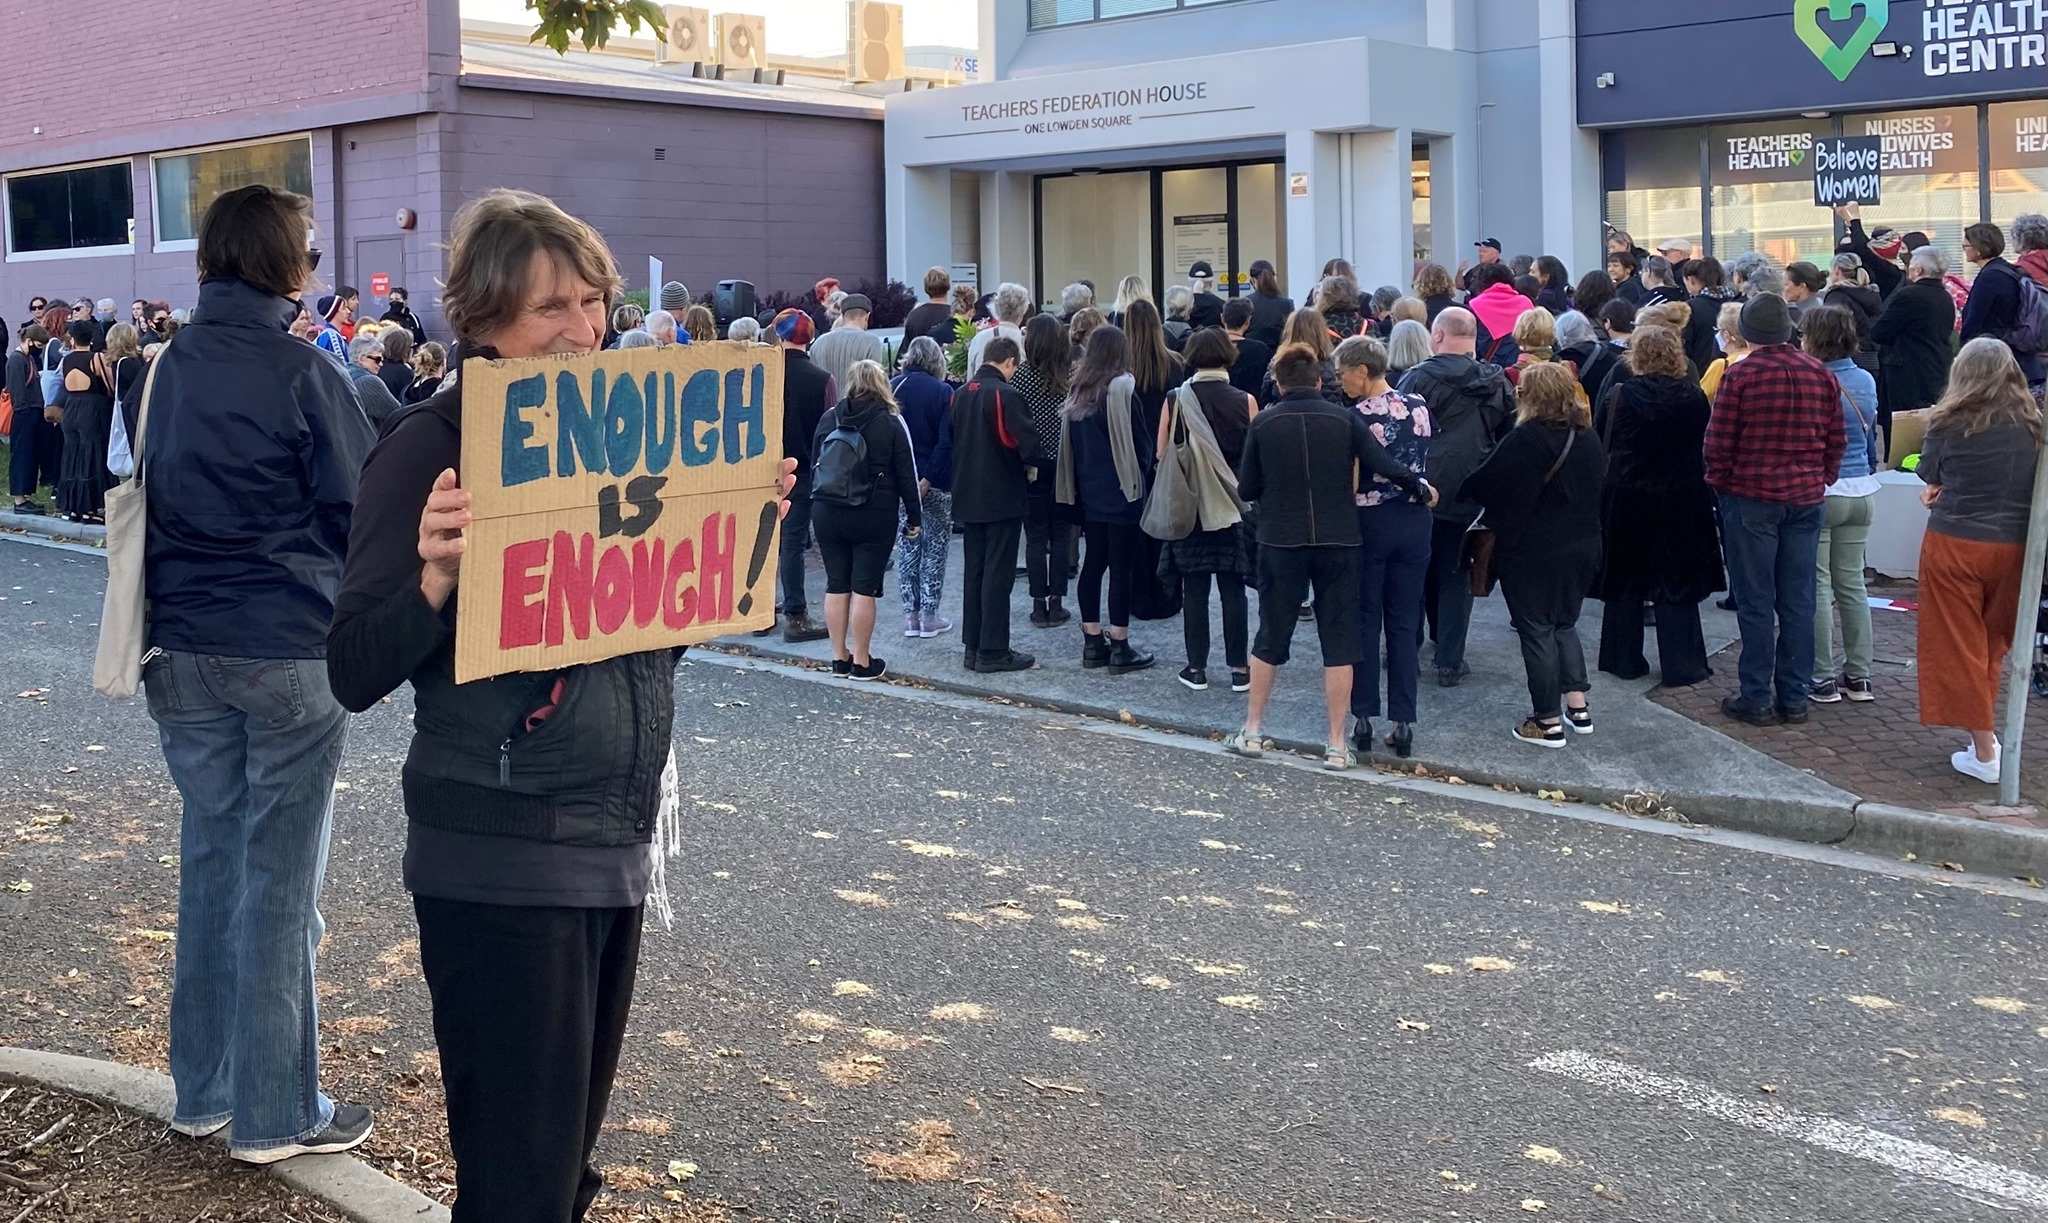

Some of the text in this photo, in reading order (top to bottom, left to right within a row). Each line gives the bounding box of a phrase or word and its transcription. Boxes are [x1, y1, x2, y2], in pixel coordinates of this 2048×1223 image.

[1922, 0, 2048, 41] HEALTH
[962, 81, 1208, 121] TEACHERS FEDERATION HOUSE
[1024, 115, 1133, 134] ONE LOWDEN SQUARE
[1865, 116, 1936, 136] NURSES
[1727, 132, 1812, 154] TEACHERS
[1815, 139, 1878, 172] Believe
[1880, 132, 1953, 153] IDWIVES
[1728, 151, 1790, 170] HEALTH
[1880, 150, 1933, 170] EALTH
[1816, 172, 1880, 203] Women
[500, 362, 767, 487] ENOUGH
[499, 500, 778, 650] ENOUGH!
